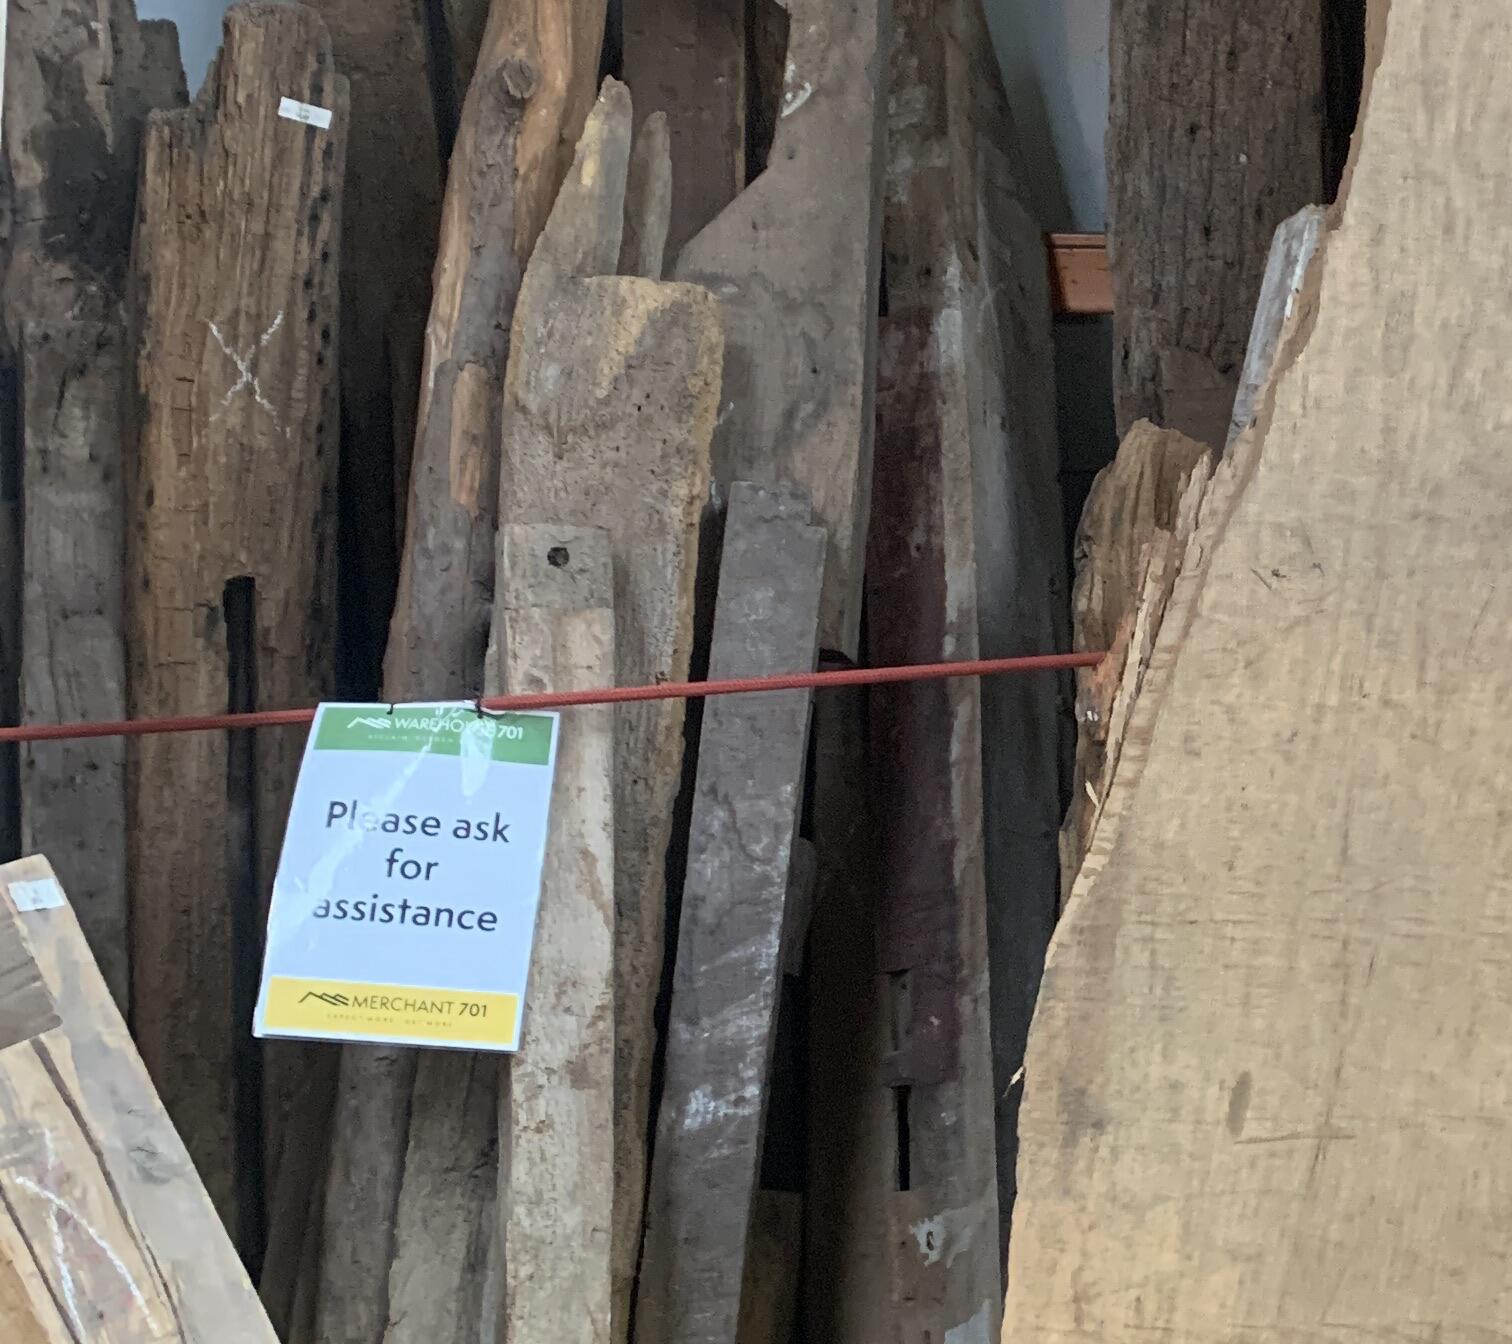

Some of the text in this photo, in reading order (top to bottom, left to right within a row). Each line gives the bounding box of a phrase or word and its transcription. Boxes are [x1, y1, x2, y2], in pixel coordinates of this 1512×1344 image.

[395, 716, 495, 738] WAREHO
[497, 725, 523, 740] 701
[325, 800, 511, 843] Please ask
[386, 848, 439, 881] for
[312, 894, 498, 932] assistance
[352, 995, 488, 1018] MERCHANT 701
